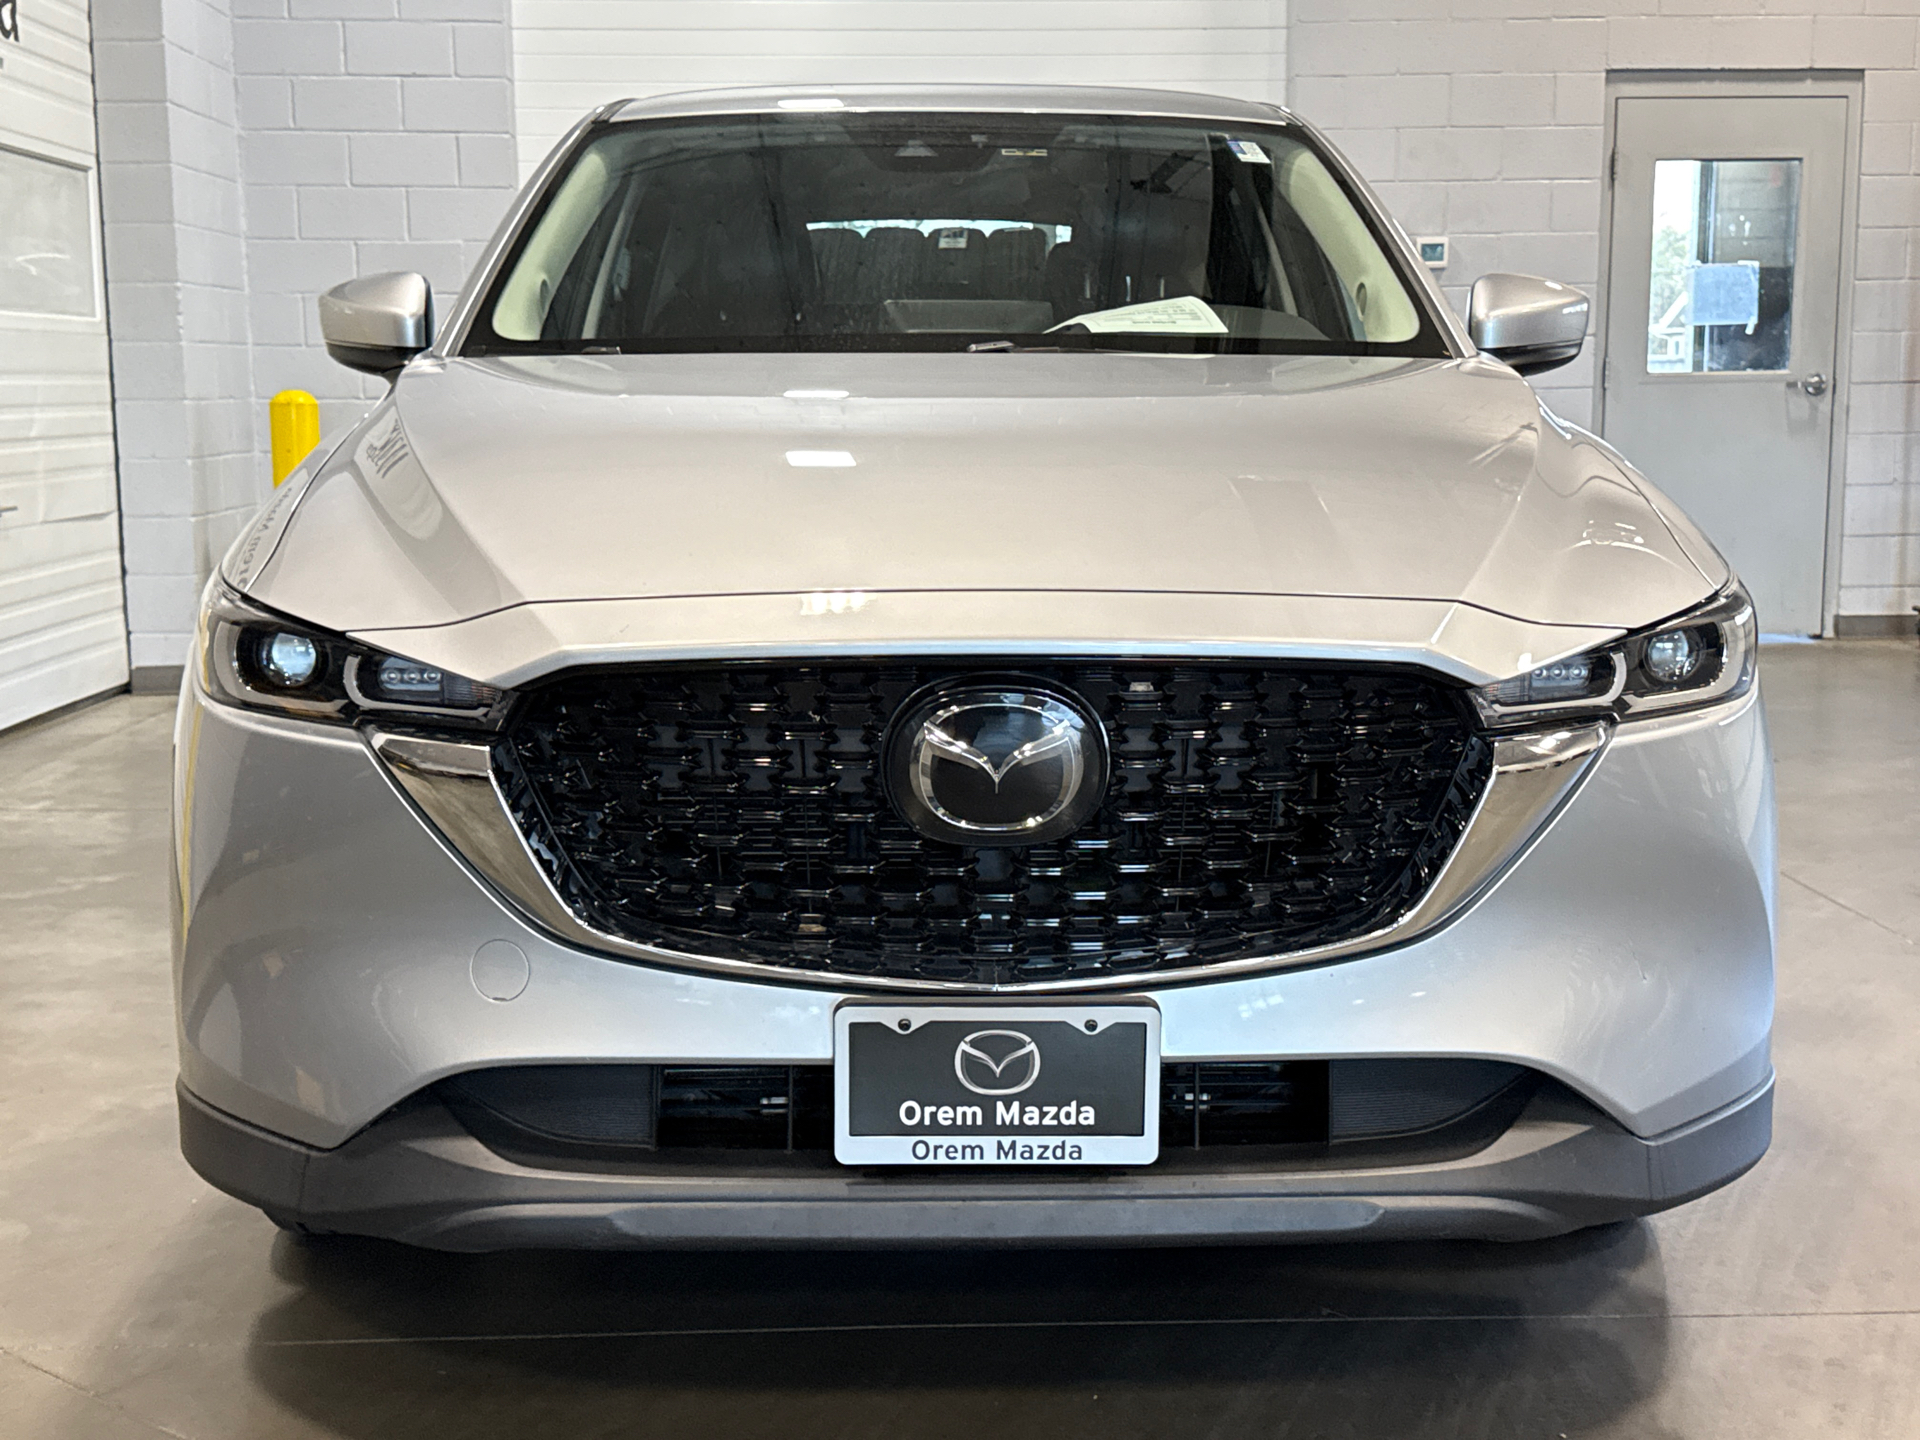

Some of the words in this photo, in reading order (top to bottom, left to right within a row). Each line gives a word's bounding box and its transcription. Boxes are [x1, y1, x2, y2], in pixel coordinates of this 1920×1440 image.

[899, 1100, 983, 1126] Orem
[995, 1100, 1095, 1126] Mazda
[911, 1139, 985, 1161] Orem
[995, 1139, 1083, 1161] Mazda
